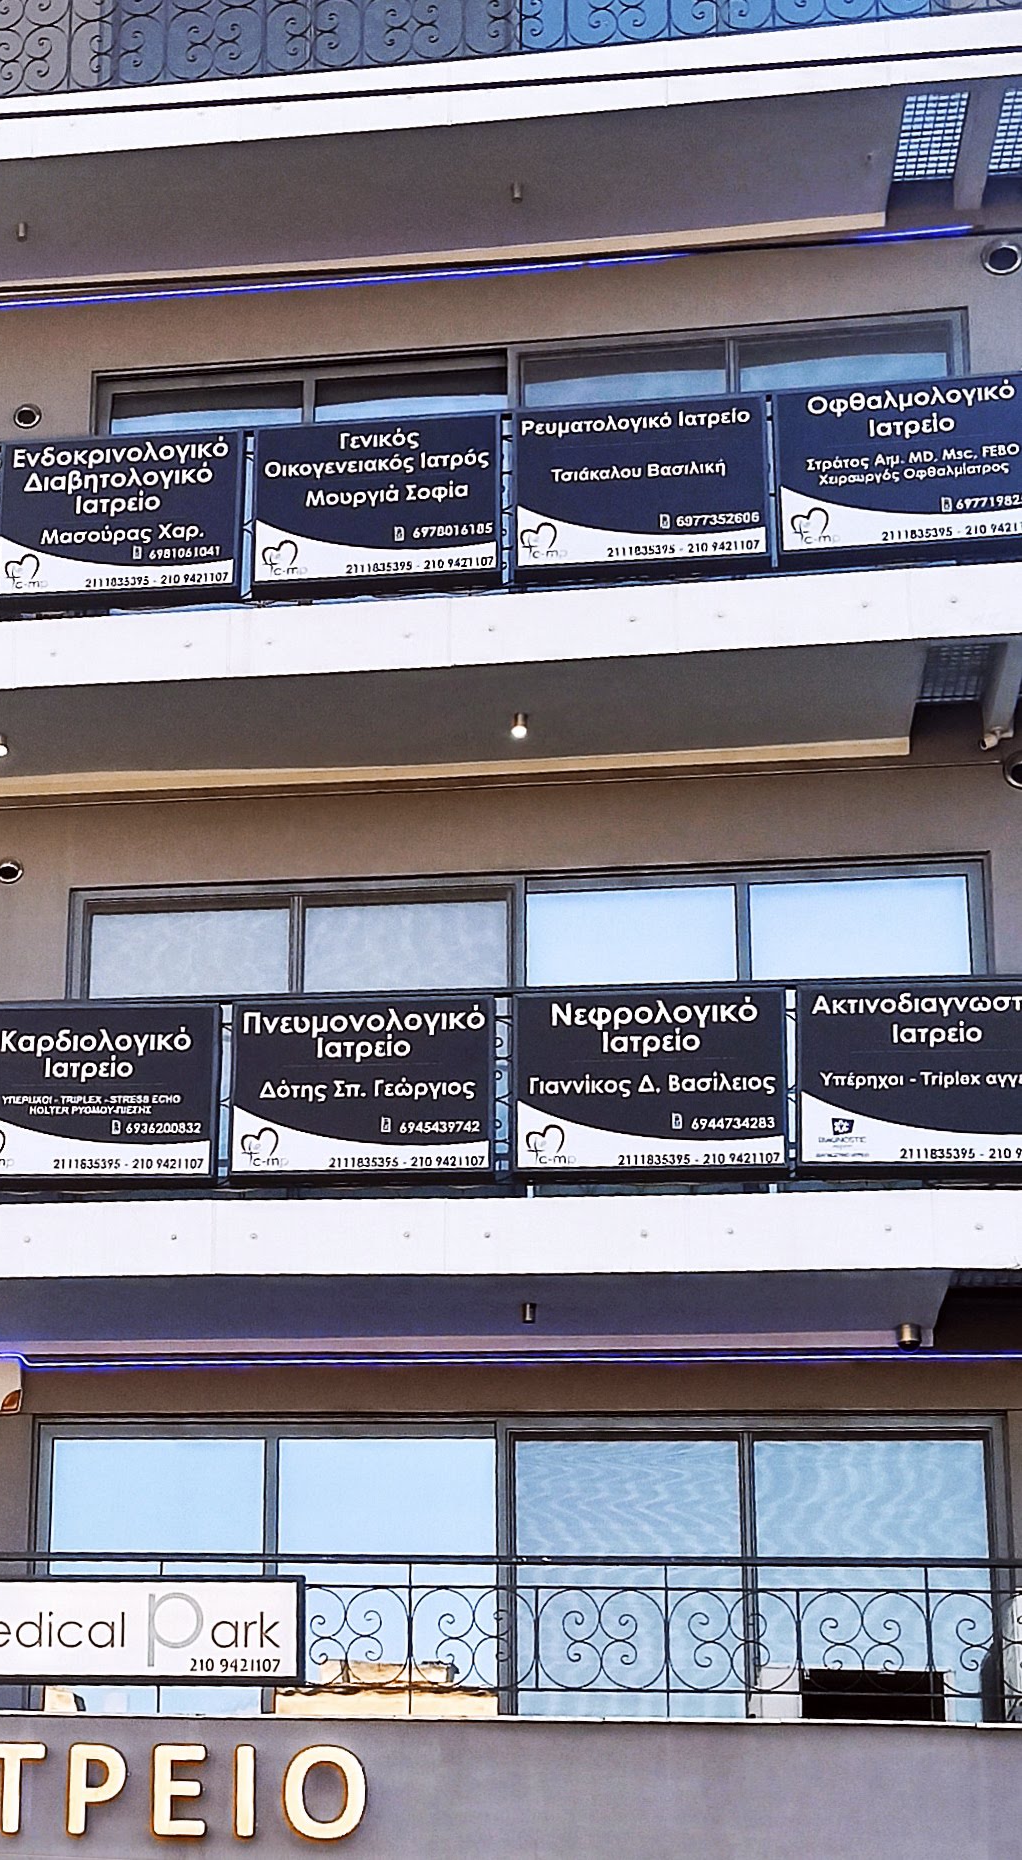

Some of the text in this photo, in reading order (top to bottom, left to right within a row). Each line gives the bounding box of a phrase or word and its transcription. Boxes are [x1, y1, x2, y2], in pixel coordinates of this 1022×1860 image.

[807, 379, 1015, 417] Οφθαλμολογικό
[521, 408, 750, 438] Ρευματολογικό Ιατρείο
[869, 413, 955, 439] Ιατρείο
[340, 428, 420, 450] Γενικός
[13, 436, 229, 468] Ενδοκρινολογικό
[265, 449, 490, 478] Οικογενειακός Ιατρός
[806, 444, 1020, 473] Στράτος FEBO
[24, 462, 213, 494] Διαβητολογικό
[551, 459, 726, 482] Τσιάκαλου Βασιλική
[819, 462, 1009, 486] Χειρουργός Οφθαλμίατρος
[75, 490, 161, 516] Ιατρείο
[305, 480, 469, 508] Μουργιά Σοφία
[956, 495, 1022, 510] 69771982
[40, 523, 204, 545] Μασούρας Χαρ.
[882, 526, 987, 541] 2111835395 210
[607, 540, 760, 557] 2111835395 210 9421107
[346, 557, 494, 574] 2111835395 210 9421107
[86, 572, 229, 588] 2111835395 210 9421107
[242, 1005, 485, 1038] Πνευμονολογικό
[551, 996, 758, 1030] Νεφρολογικό
[0, 1026, 192, 1057] Καρδιολογικό
[602, 1028, 701, 1057] Ιατρείο
[892, 1021, 983, 1047] Ιατρείο
[317, 1034, 411, 1063] Ιατρείο
[44, 1054, 134, 1082] Ιατρείο
[259, 1077, 476, 1101] Δότης Σπ. Γεώργιος
[529, 1071, 776, 1097] Γιαννίκος Δ. Βασίλειος
[820, 1072, 904, 1090] Υπέρηχοι
[920, 1071, 980, 1089] Triplex
[152, 1094, 181, 1103] ECHO
[399, 1121, 480, 1134] 6945439742
[691, 1116, 775, 1130] 6944734283
[53, 1158, 204, 1170] 2111835395 210 9421107
[329, 1156, 484, 1168] 2111835395 210 9421107
[618, 1152, 780, 1165] 2111835395 210 9421107
[900, 1148, 1011, 1159] 2111835395 210
[189, 1657, 281, 1674] 210 9421107
